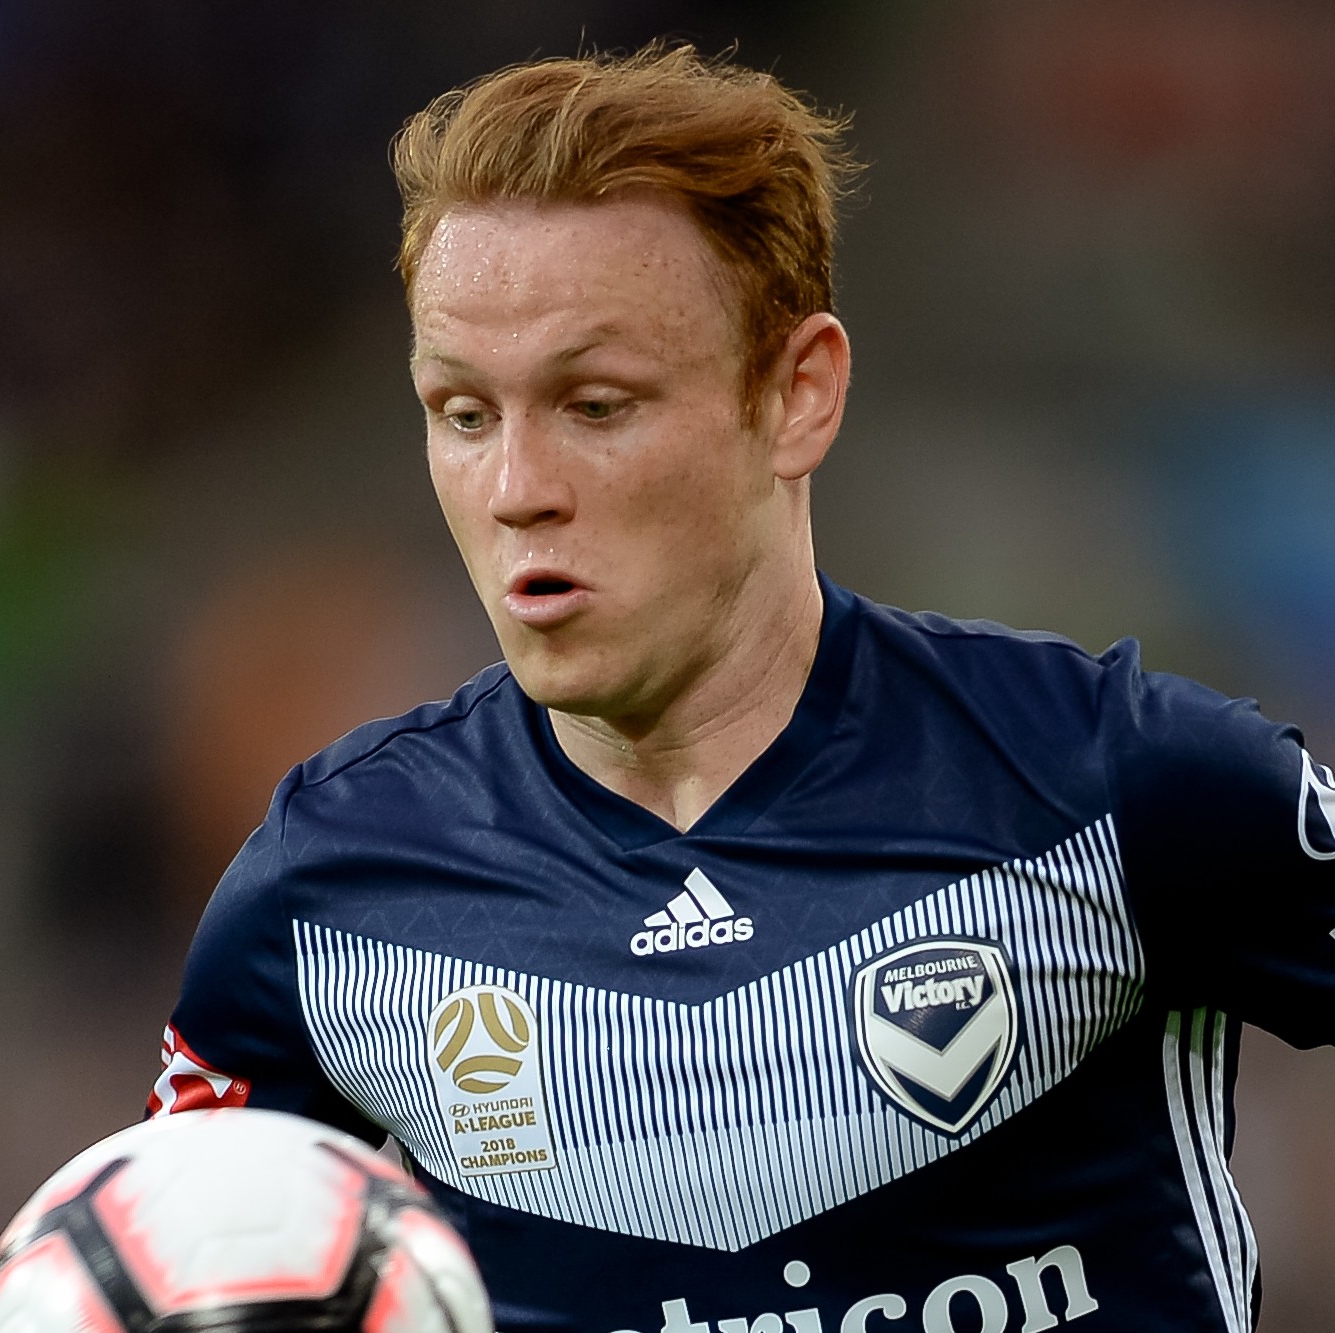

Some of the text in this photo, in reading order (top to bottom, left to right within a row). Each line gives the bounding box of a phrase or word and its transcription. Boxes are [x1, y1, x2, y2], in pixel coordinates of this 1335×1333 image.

[630, 917, 754, 956] adidas
[884, 955, 978, 983] MELBOURNE
[881, 975, 984, 1013] Victory
[473, 1097, 533, 1114] HYUNDAI
[480, 1138, 516, 1153] 2018
[460, 1149, 548, 1169] CHAMPIONS
